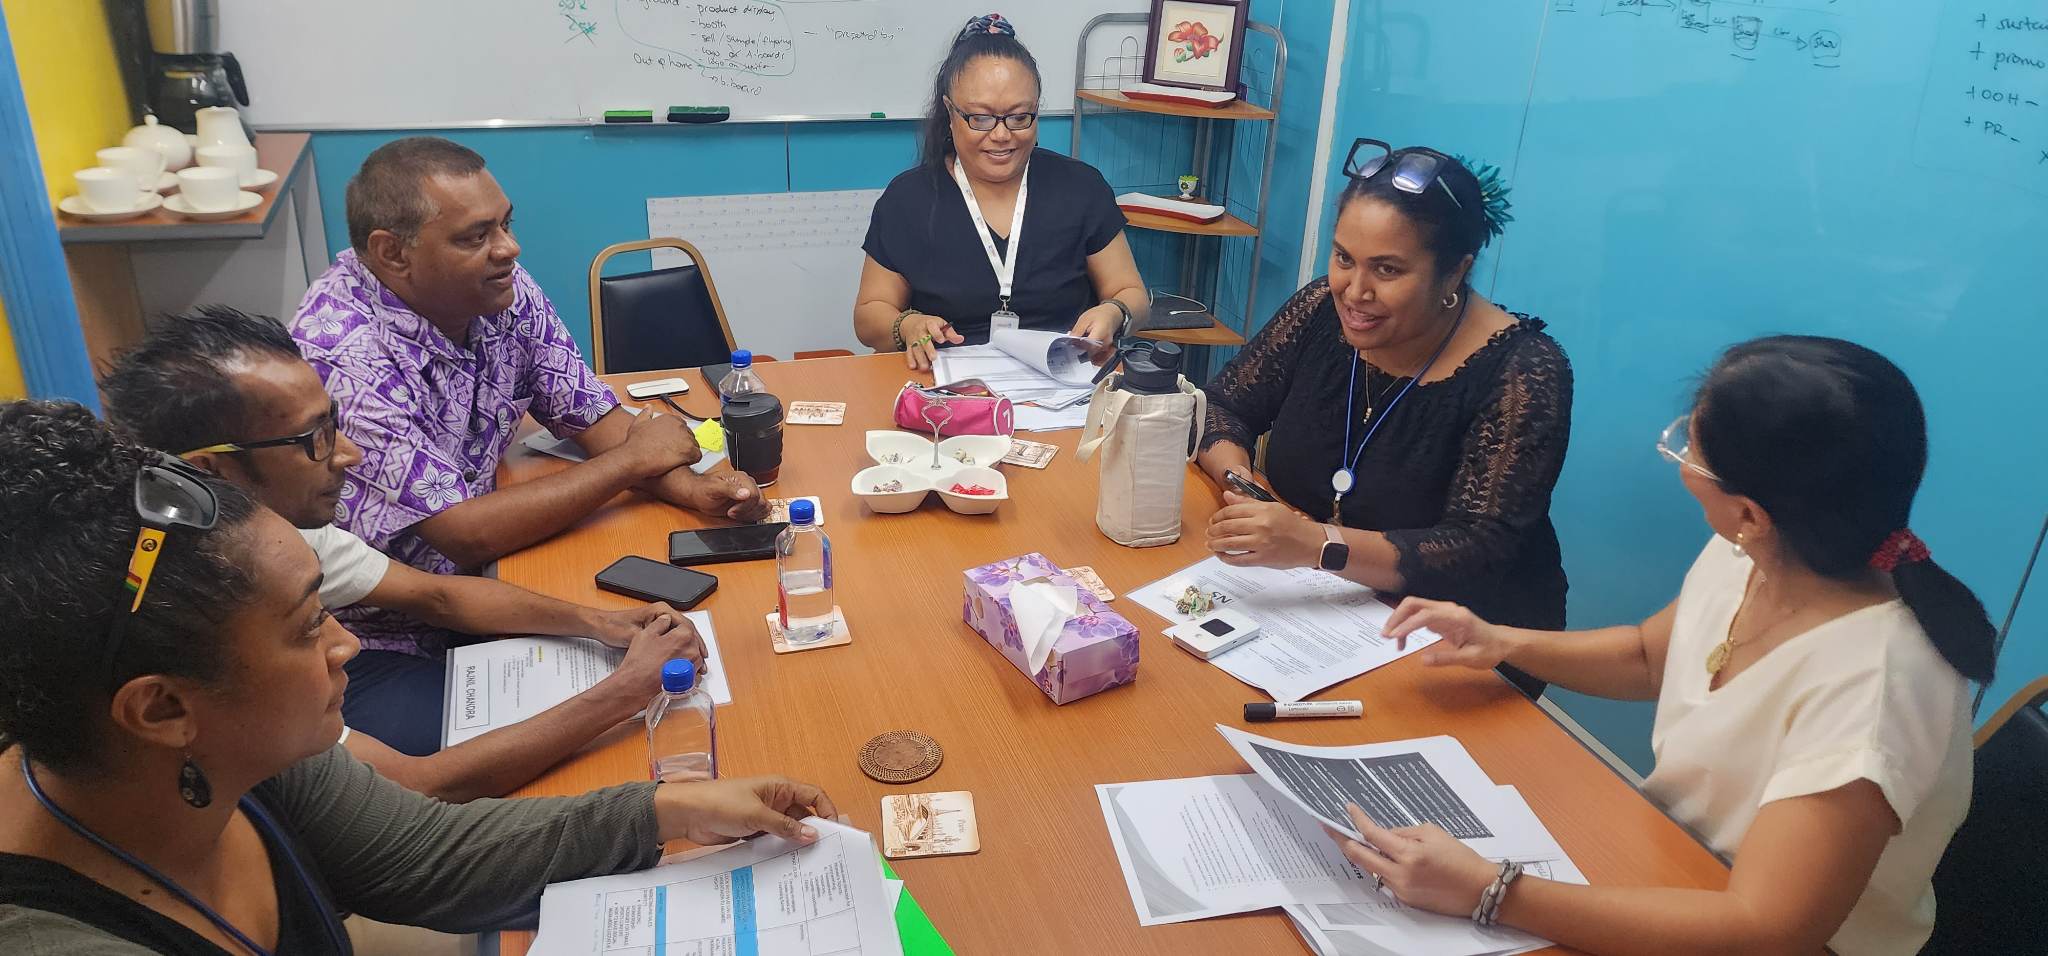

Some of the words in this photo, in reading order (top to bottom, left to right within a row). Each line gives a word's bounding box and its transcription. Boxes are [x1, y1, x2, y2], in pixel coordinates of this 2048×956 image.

[697, 5, 738, 16] product
[699, 18, 727, 29] booth
[1993, 52, 2046, 70] promo
[1984, 121, 2007, 137] PR
[465, 688, 476, 721] CHANDRA
